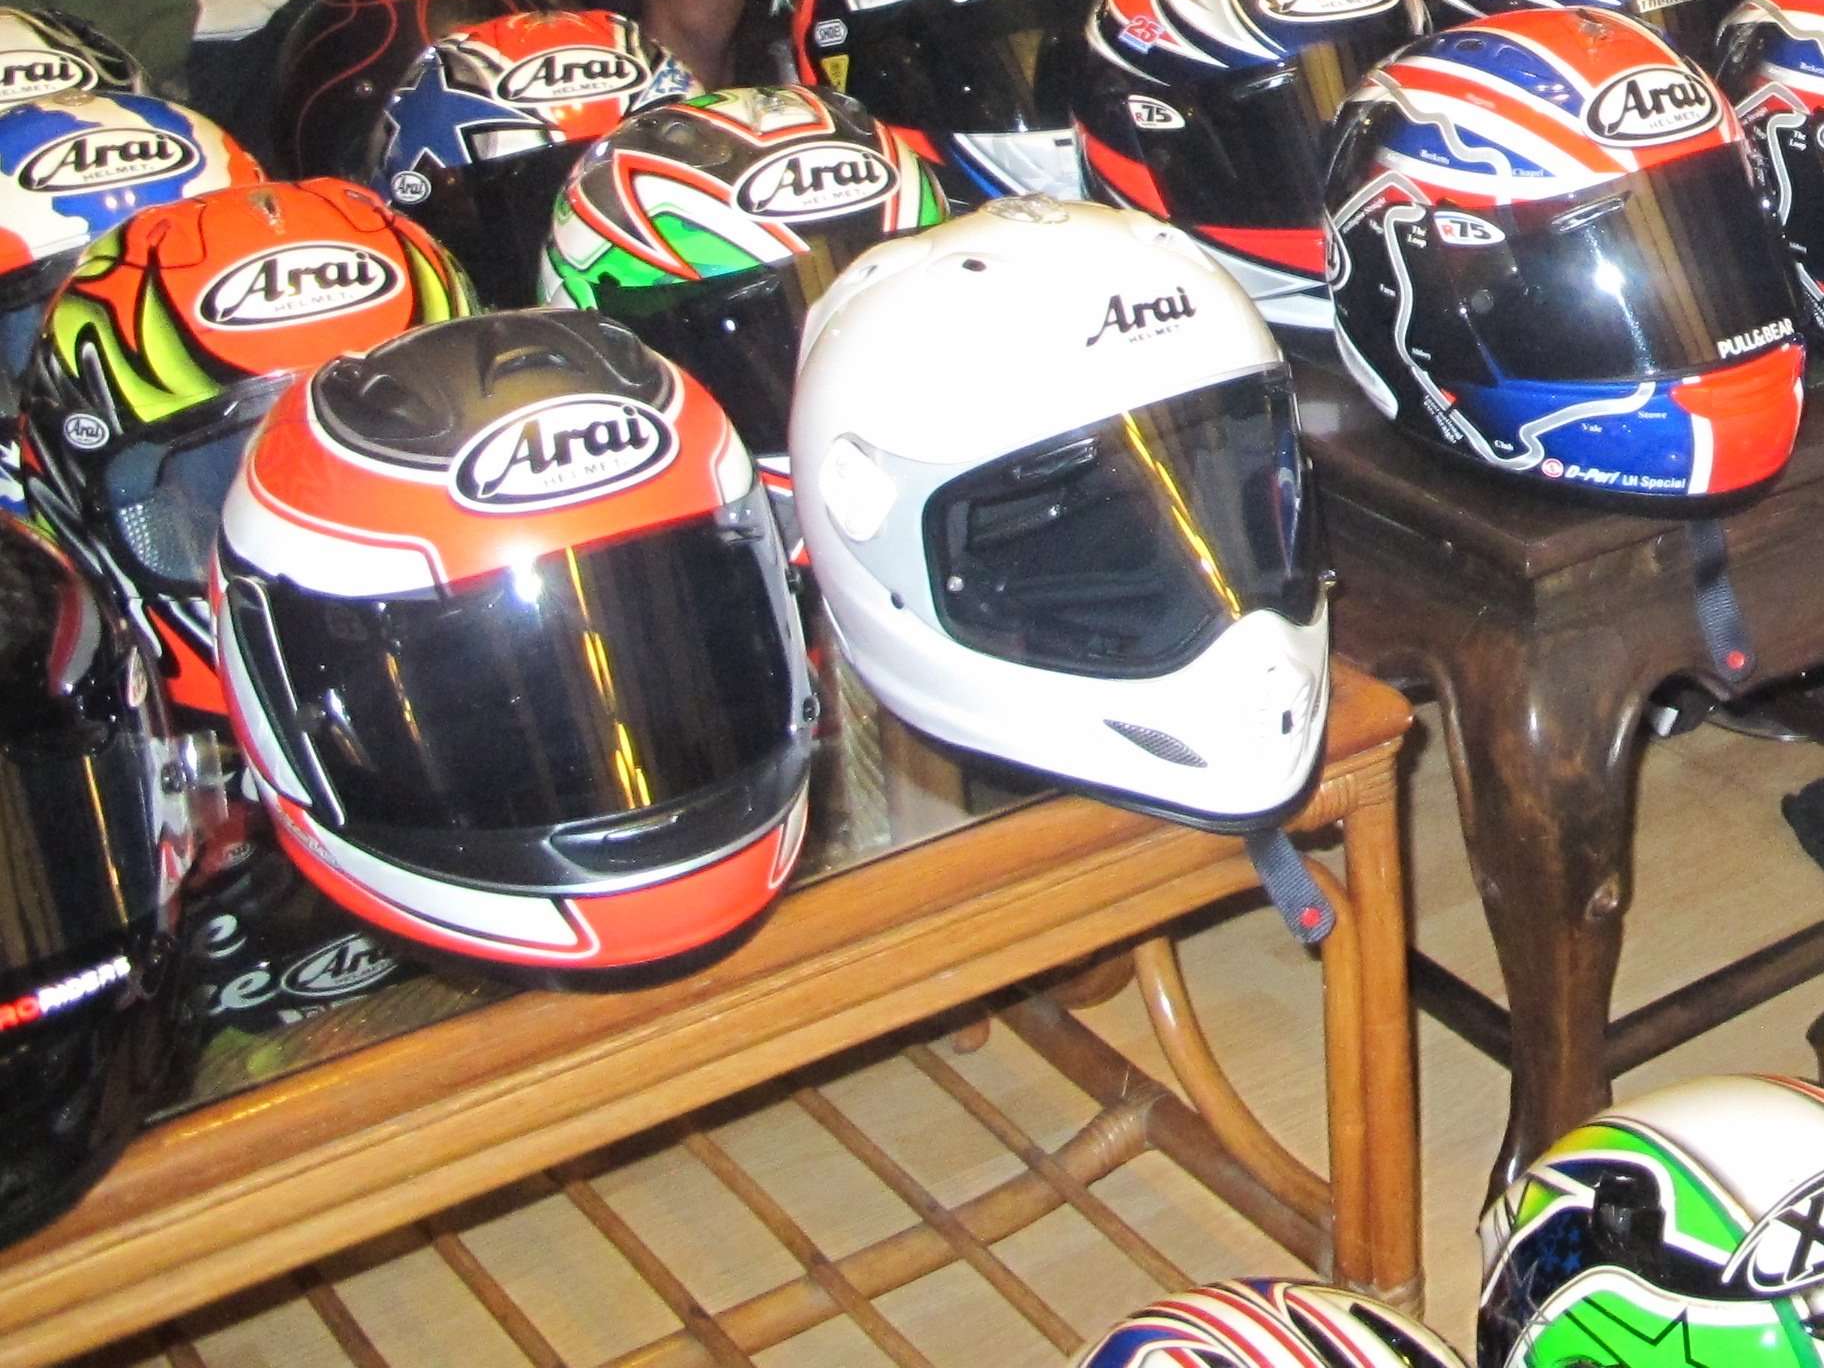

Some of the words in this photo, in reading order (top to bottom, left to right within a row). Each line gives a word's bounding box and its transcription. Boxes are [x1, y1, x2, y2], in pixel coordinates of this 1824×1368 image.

[0, 57, 75, 86] rai
[509, 55, 631, 100] Arai
[1603, 75, 1706, 137] Arai
[33, 134, 173, 189] Arai
[752, 151, 881, 212] Arai
[216, 252, 376, 321] Arai
[1086, 286, 1197, 347] Arai
[1716, 318, 1794, 359] PULL&BEAR
[477, 405, 649, 498] Arai
[1641, 475, 1686, 489] Special
